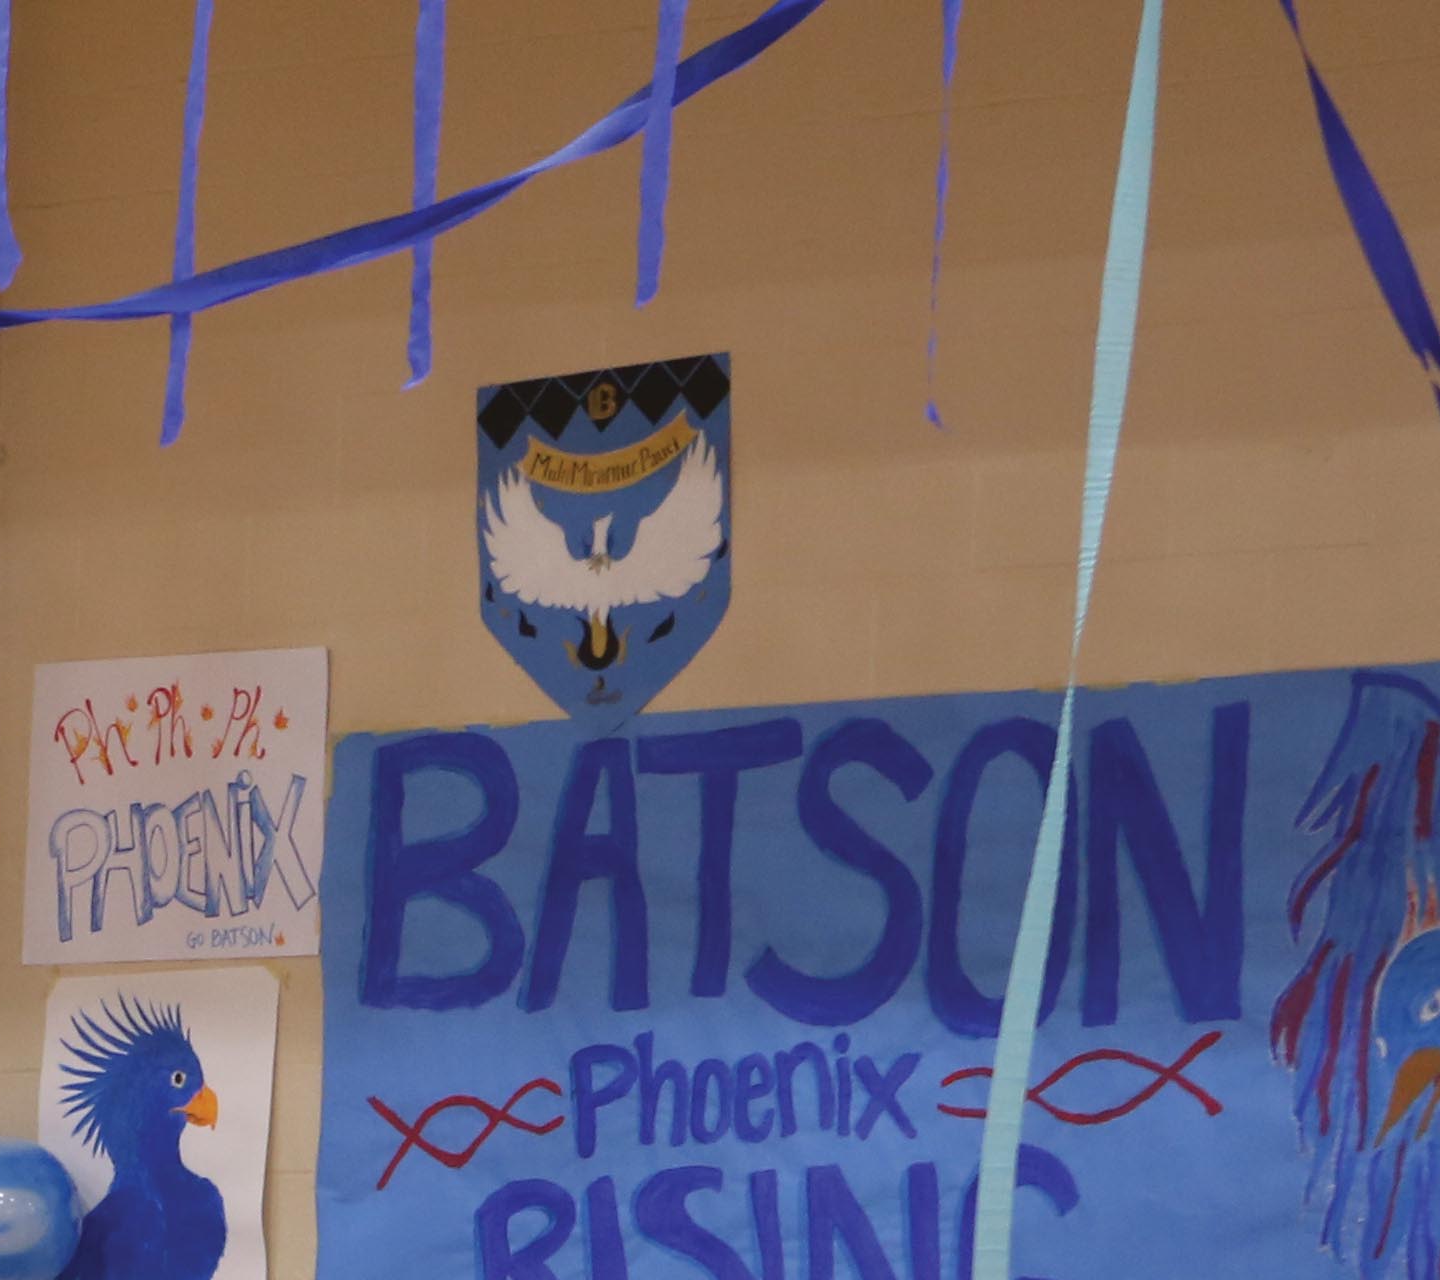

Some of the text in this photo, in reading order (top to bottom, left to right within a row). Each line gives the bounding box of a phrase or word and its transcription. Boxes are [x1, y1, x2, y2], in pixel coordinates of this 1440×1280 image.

[588, 383, 616, 421] B
[358, 700, 1251, 1037] BATSON
[571, 1031, 924, 1157] Phoenix
